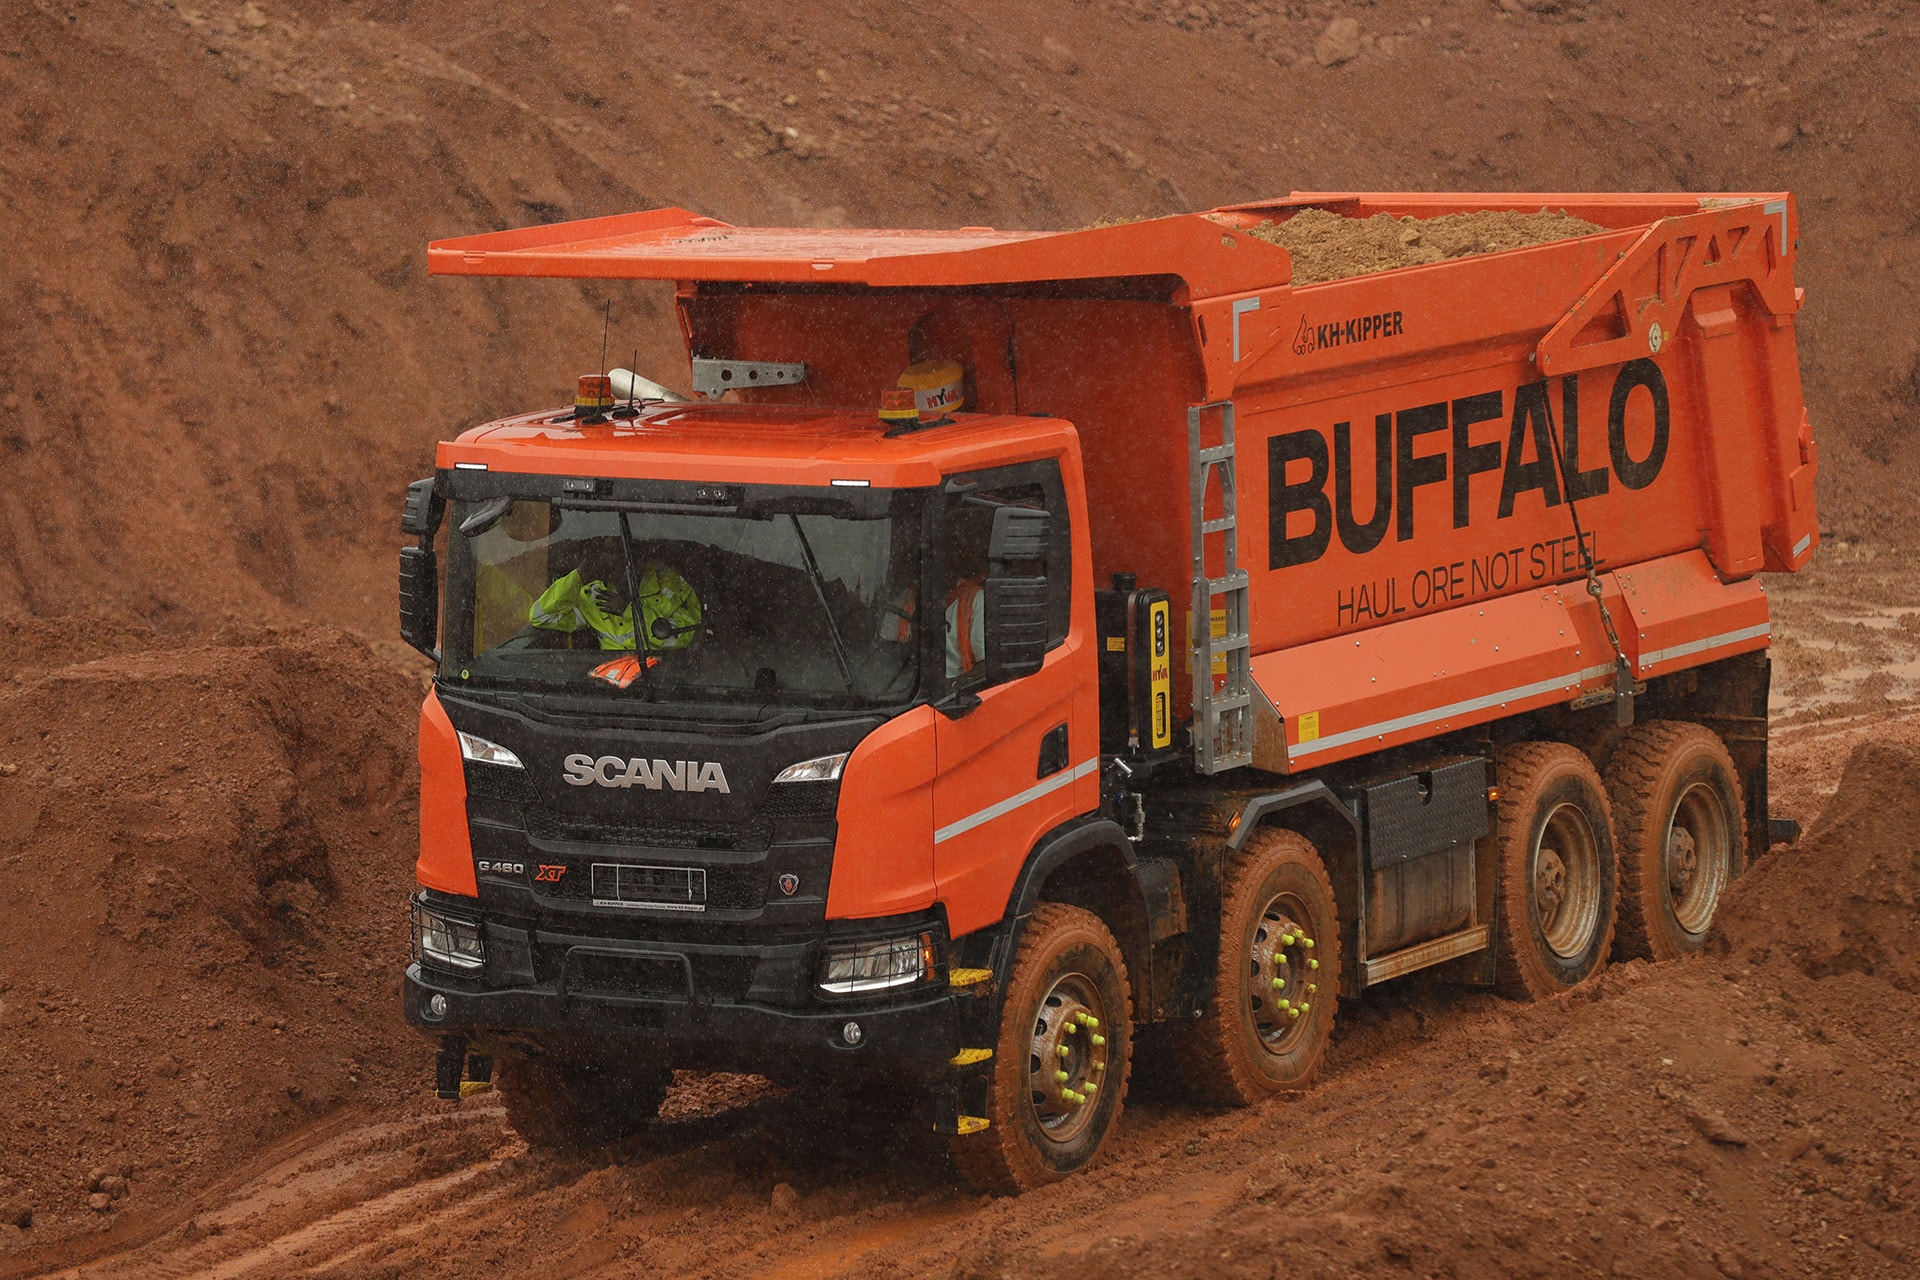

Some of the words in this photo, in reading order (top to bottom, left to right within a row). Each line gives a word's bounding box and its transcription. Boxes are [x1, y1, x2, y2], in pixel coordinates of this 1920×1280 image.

[1317, 311, 1403, 349] KH-KIPPER
[1267, 357, 1670, 571] BUFFALO
[1337, 577, 1406, 627] HAUL
[1412, 562, 1465, 609] ORE
[1471, 547, 1525, 596] NOT
[1529, 531, 1606, 581] STEEL
[562, 753, 731, 794] SCANIA
[478, 861, 490, 872] G
[491, 862, 525, 875] 460
[534, 865, 567, 882] XT
